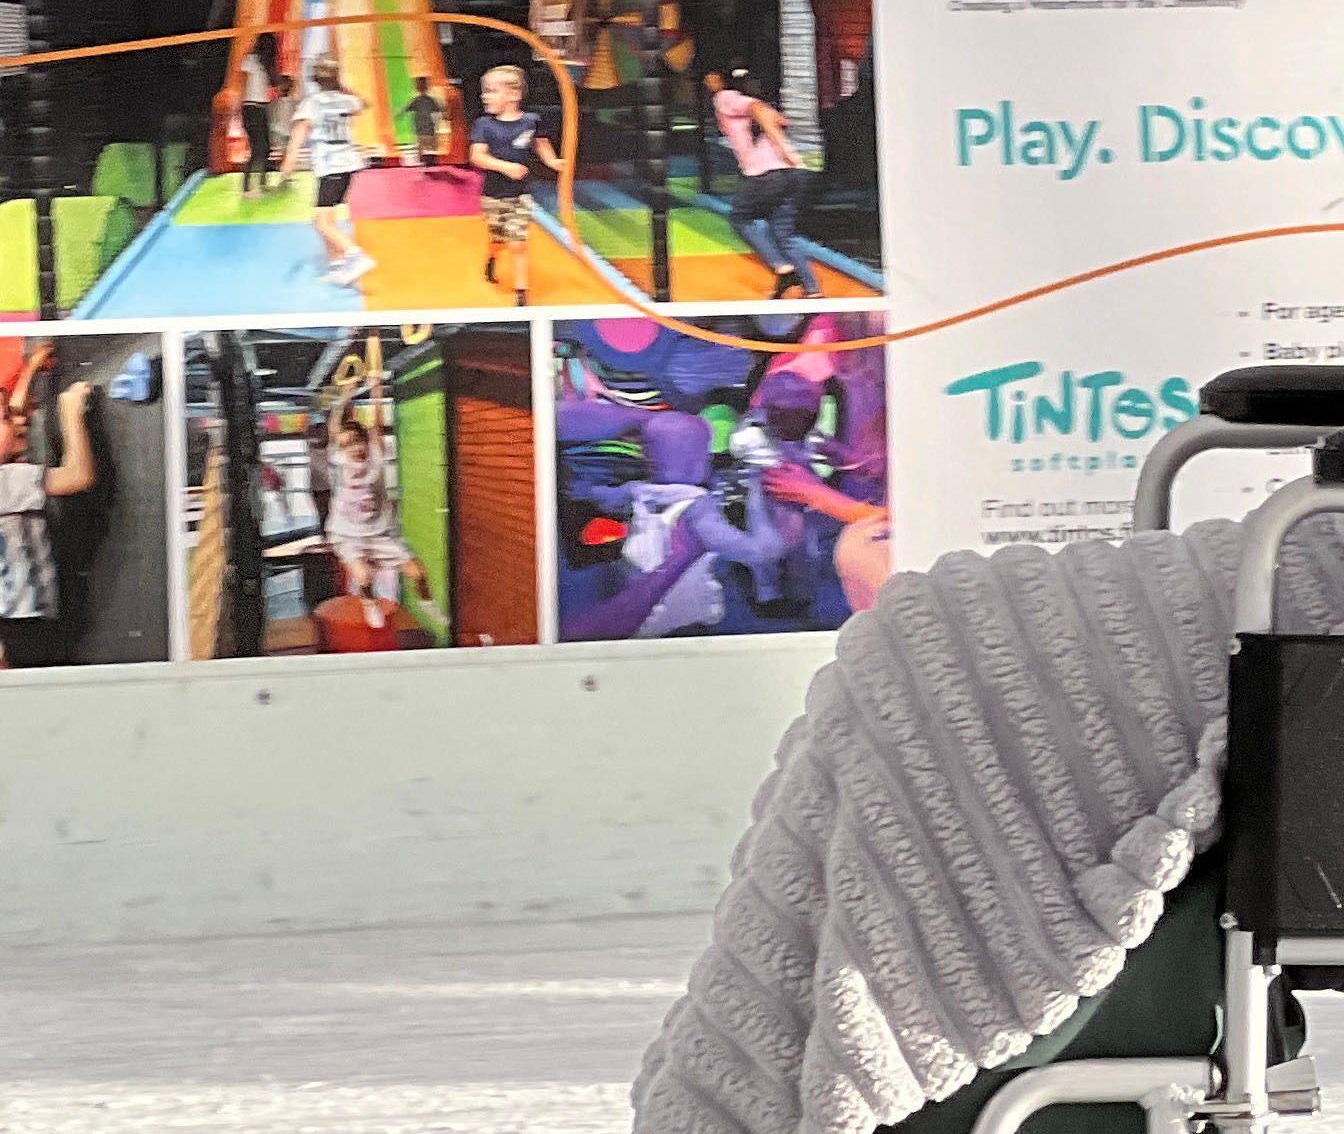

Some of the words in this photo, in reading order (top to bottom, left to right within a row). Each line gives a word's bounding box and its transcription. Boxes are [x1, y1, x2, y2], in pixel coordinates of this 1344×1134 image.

[953, 99, 1113, 180] Play.
[1263, 341, 1322, 364] Baby
[981, 499, 1034, 518] Find
[1038, 500, 1078, 517] out
